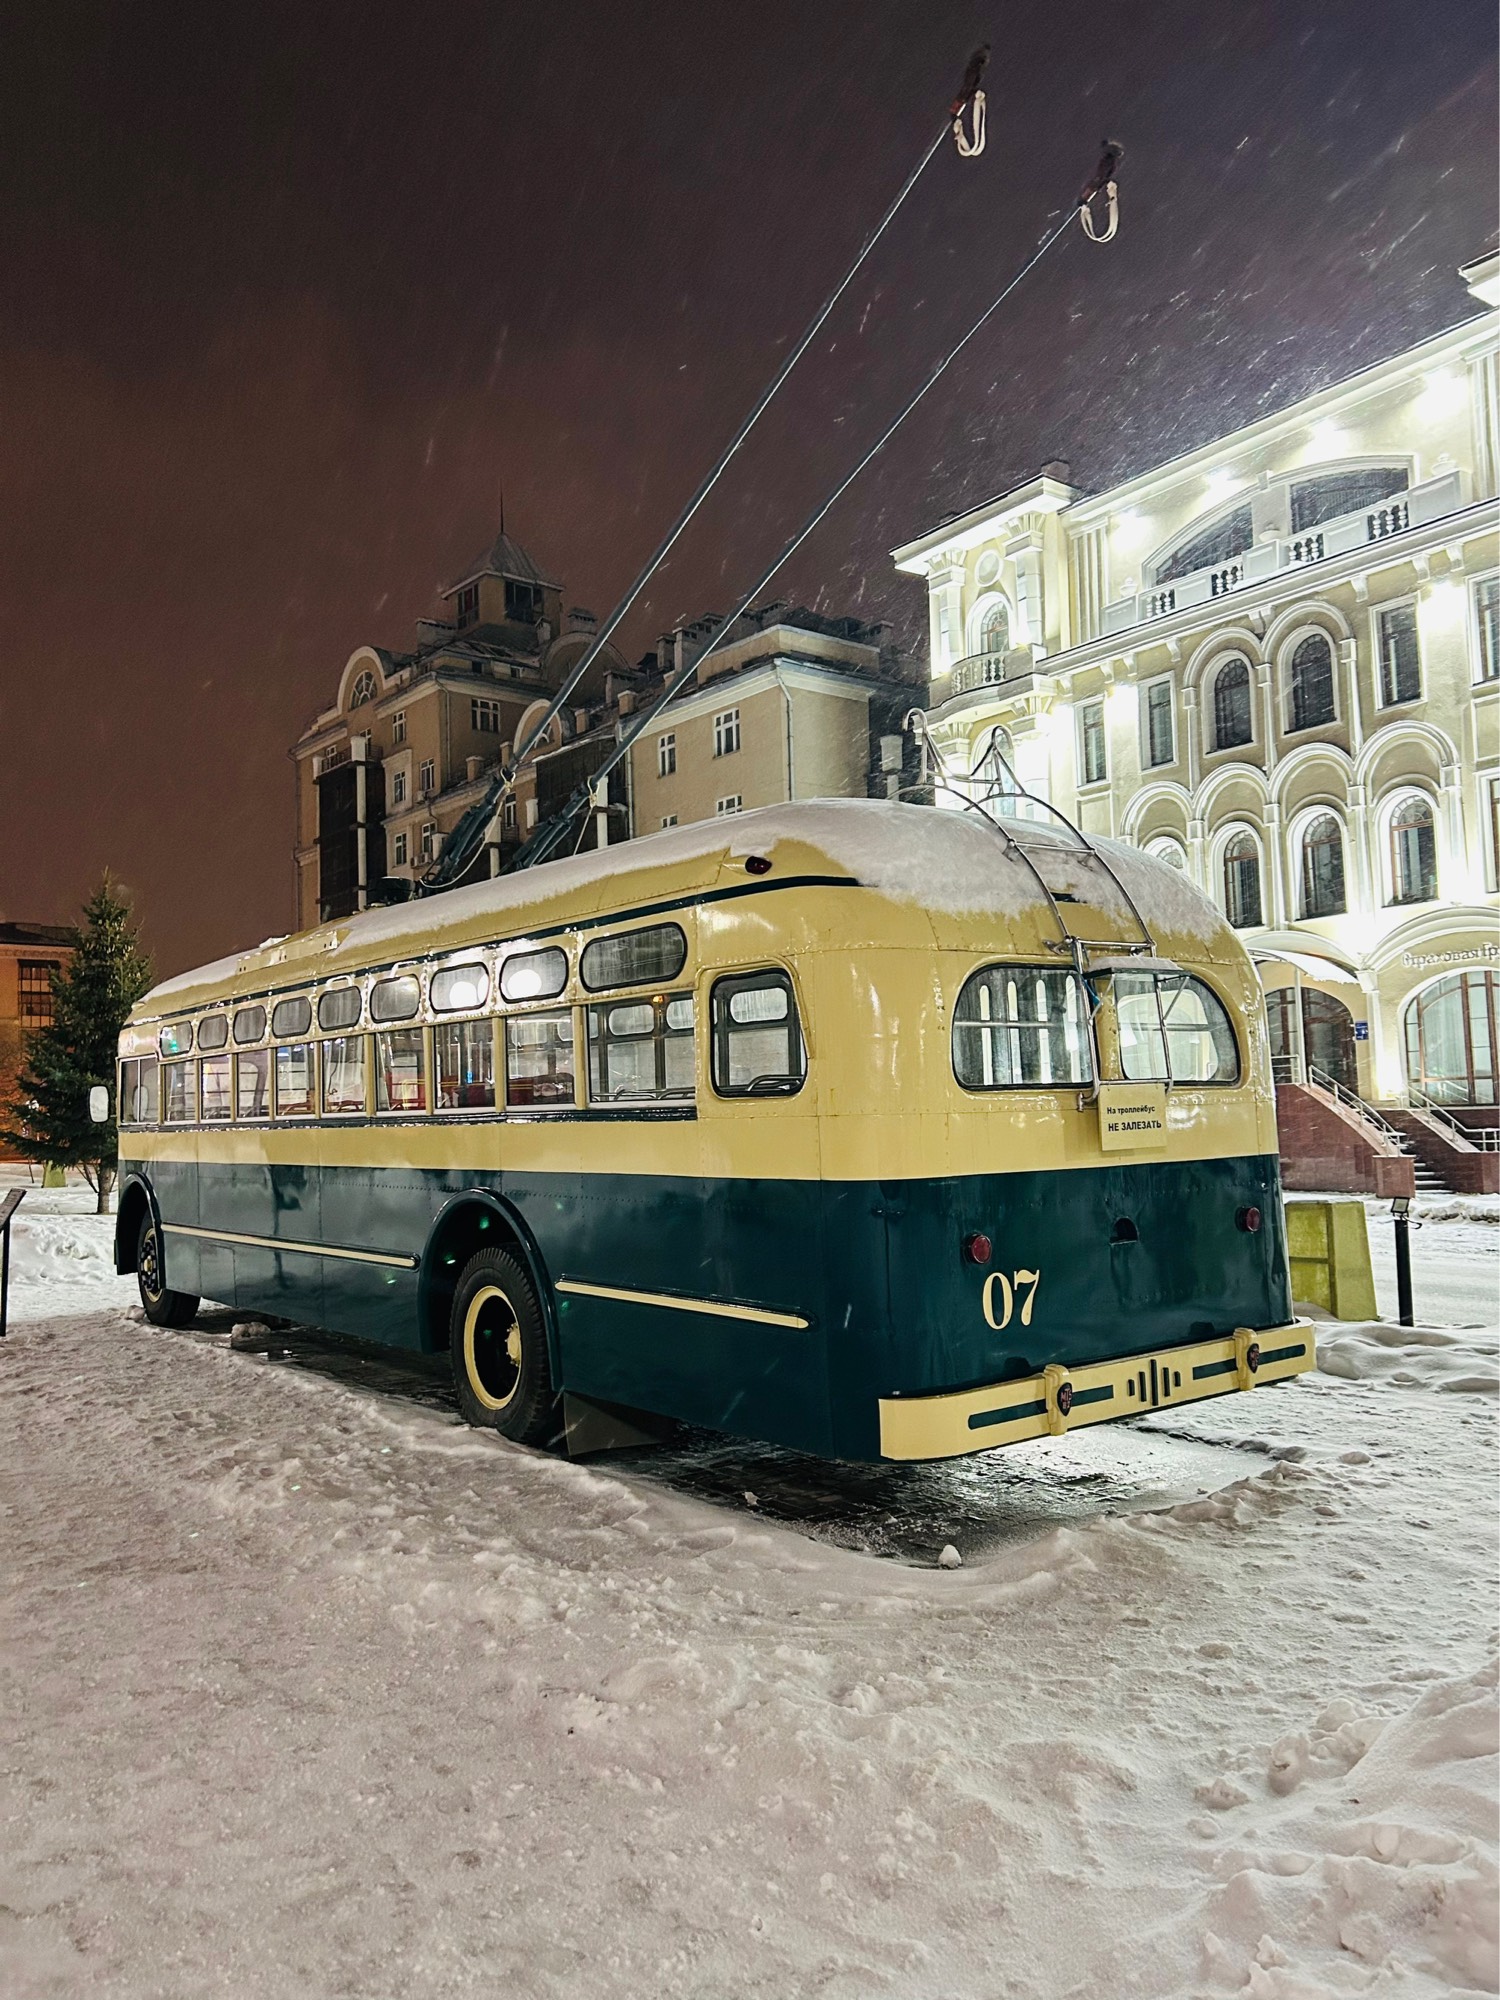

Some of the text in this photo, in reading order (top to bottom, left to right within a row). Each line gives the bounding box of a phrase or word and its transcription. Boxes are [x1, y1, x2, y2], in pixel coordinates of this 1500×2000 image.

[1402, 942, 1499, 969] Страховая Гр
[1107, 1105, 1156, 1116] На троллейбус
[1108, 1120, 1162, 1132] НЕ ЗАЛЕЗАТЬ
[982, 1268, 1040, 1330] 07
